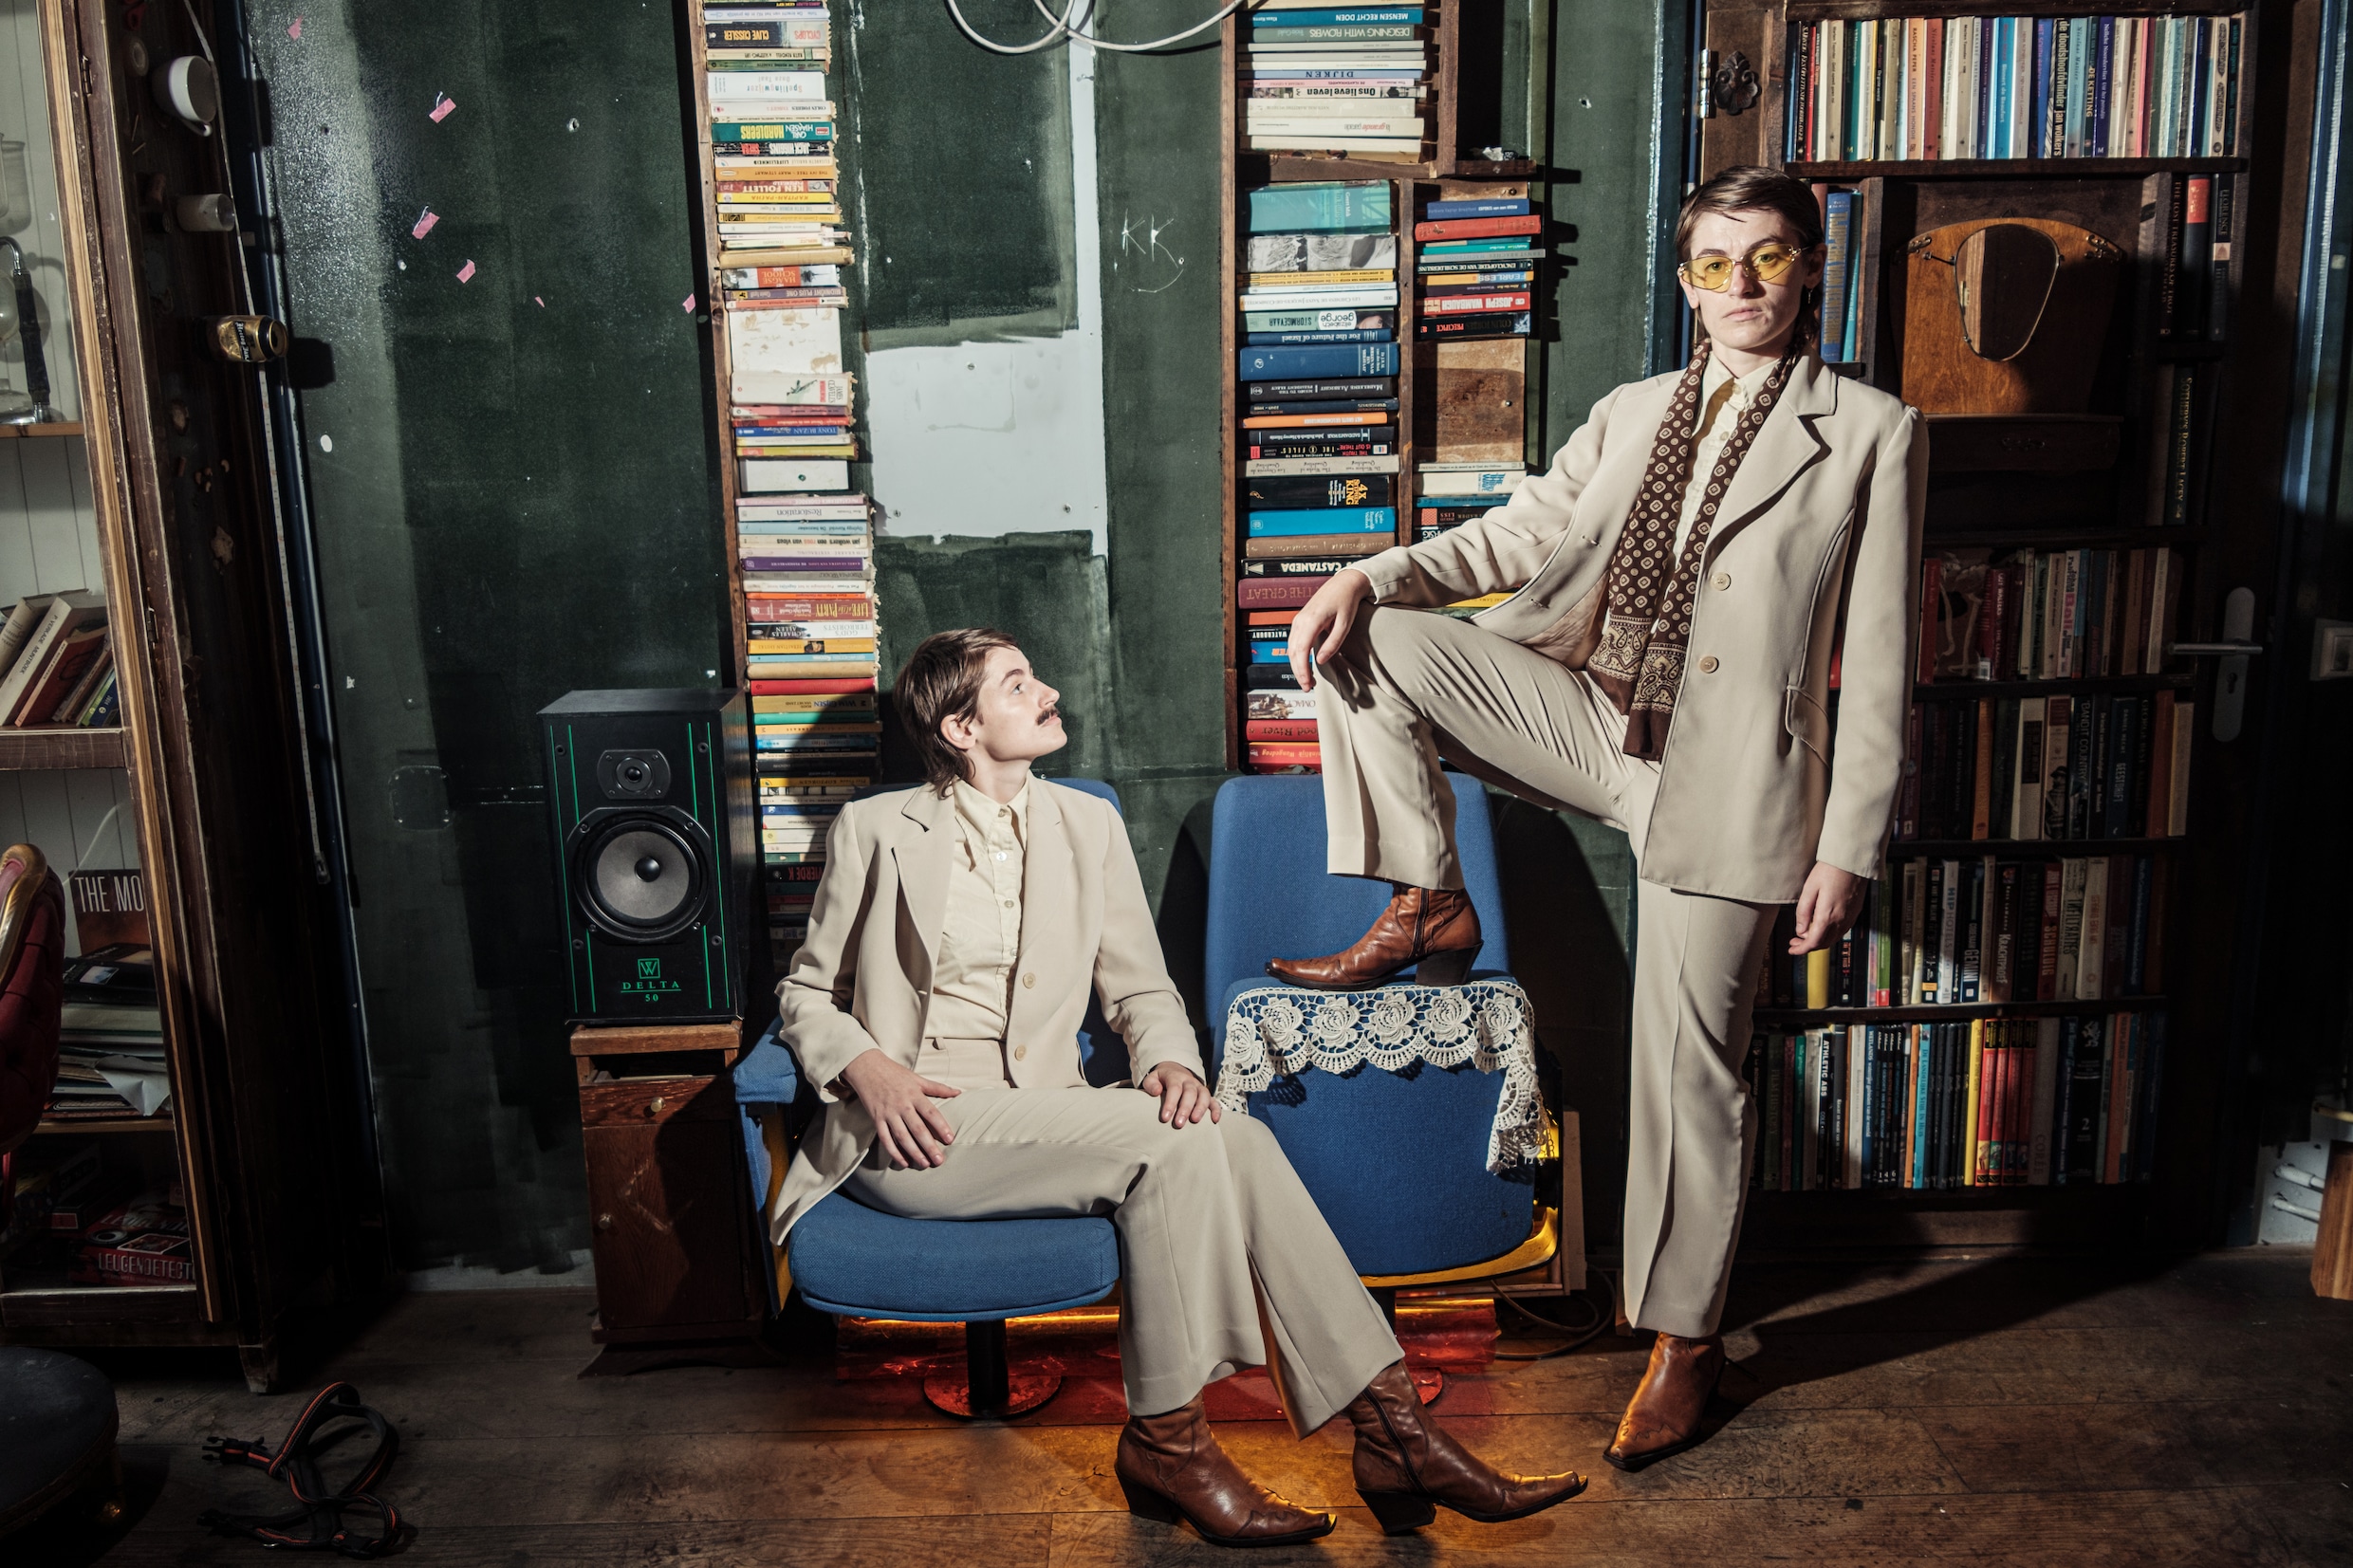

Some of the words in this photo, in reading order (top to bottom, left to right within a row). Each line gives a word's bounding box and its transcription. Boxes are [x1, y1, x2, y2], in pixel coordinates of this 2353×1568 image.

[1367, 27, 1410, 37] DESIGNING
[2059, 21, 2069, 31] de
[724, 30, 750, 40] CUSSLER
[751, 30, 769, 40] CLIVE
[794, 30, 821, 40] CYCLOPS
[1308, 28, 1342, 38] FLOWERS
[1343, 28, 1366, 37] WITH
[2056, 33, 2068, 107] doodshoofdvlinder
[2089, 68, 2095, 79] DE
[747, 84, 803, 93] Spellingwijzer
[1306, 88, 1333, 97] leven
[1334, 88, 1357, 97] lieve
[1358, 87, 1376, 96] Ons
[2086, 81, 2095, 117] KETTING
[2054, 109, 2066, 122] jan
[2054, 124, 2065, 156] wolkers
[769, 143, 794, 154] HIGGINS
[794, 143, 809, 154] JACK
[2220, 189, 2231, 236] FLORENCE
[2169, 227, 2178, 273] TREASURES
[2168, 274, 2175, 286] OF
[1442, 299, 1483, 310] WAMBAUGH
[1485, 297, 1513, 308] JOSEPH
[1269, 317, 1312, 326] STORMGEVAAR
[1321, 312, 1354, 323] george
[2179, 378, 2193, 429] SOTHEBY'S
[2177, 432, 2189, 470] ROBERT
[1359, 484, 1368, 499] 4X
[2176, 471, 2187, 501] LACEY
[1281, 563, 1342, 572] CASTANEDA
[1247, 588, 1287, 600] GREAT
[1290, 587, 1311, 598] THE
[816, 603, 838, 618] PARTY
[852, 602, 868, 618] LIFE
[37, 619, 57, 645] VERKADE
[20, 646, 40, 674] MUNTBOEK
[2080, 702, 2090, 736] BANDIT
[1262, 728, 1292, 736] River
[1297, 728, 1318, 736] lood
[2079, 739, 2088, 780] COUNTRY
[788, 867, 794, 880] K
[797, 866, 823, 880] VIERDE
[74, 874, 111, 913] THE
[1947, 888, 1955, 911] HIP
[1945, 912, 1955, 948] HOTELS
[2042, 925, 2058, 976] SCHULDIG
[1963, 949, 1979, 982] GEMINI
[622, 981, 679, 989] DELTA
[1922, 1049, 1928, 1059] DE
[2082, 1118, 2089, 1131] 2
